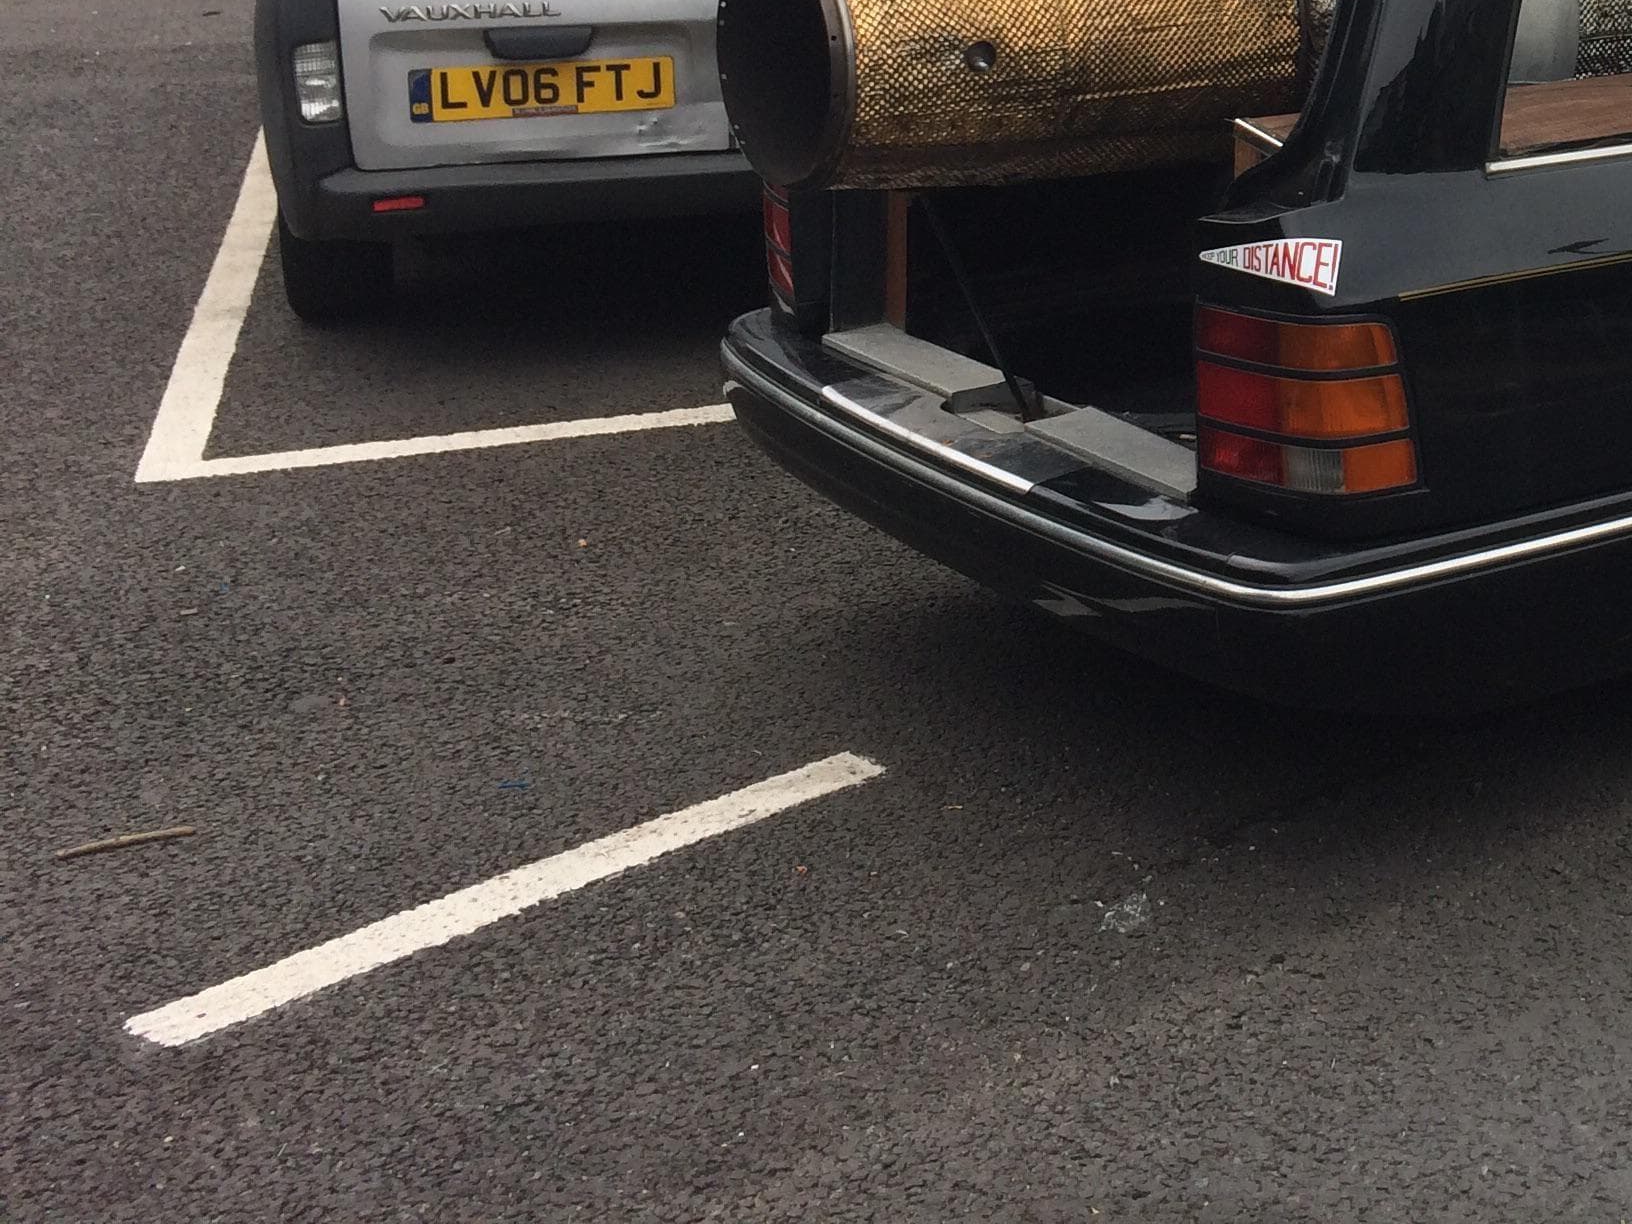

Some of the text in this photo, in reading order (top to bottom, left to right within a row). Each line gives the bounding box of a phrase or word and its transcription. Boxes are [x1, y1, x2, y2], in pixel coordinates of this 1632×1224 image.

[379, 1, 562, 23] VAUXHALL
[440, 61, 663, 110] LV06 FTJ
[412, 102, 430, 116] GB
[1215, 248, 1239, 267] YOUR
[1243, 241, 1339, 291] DISTANCE!
